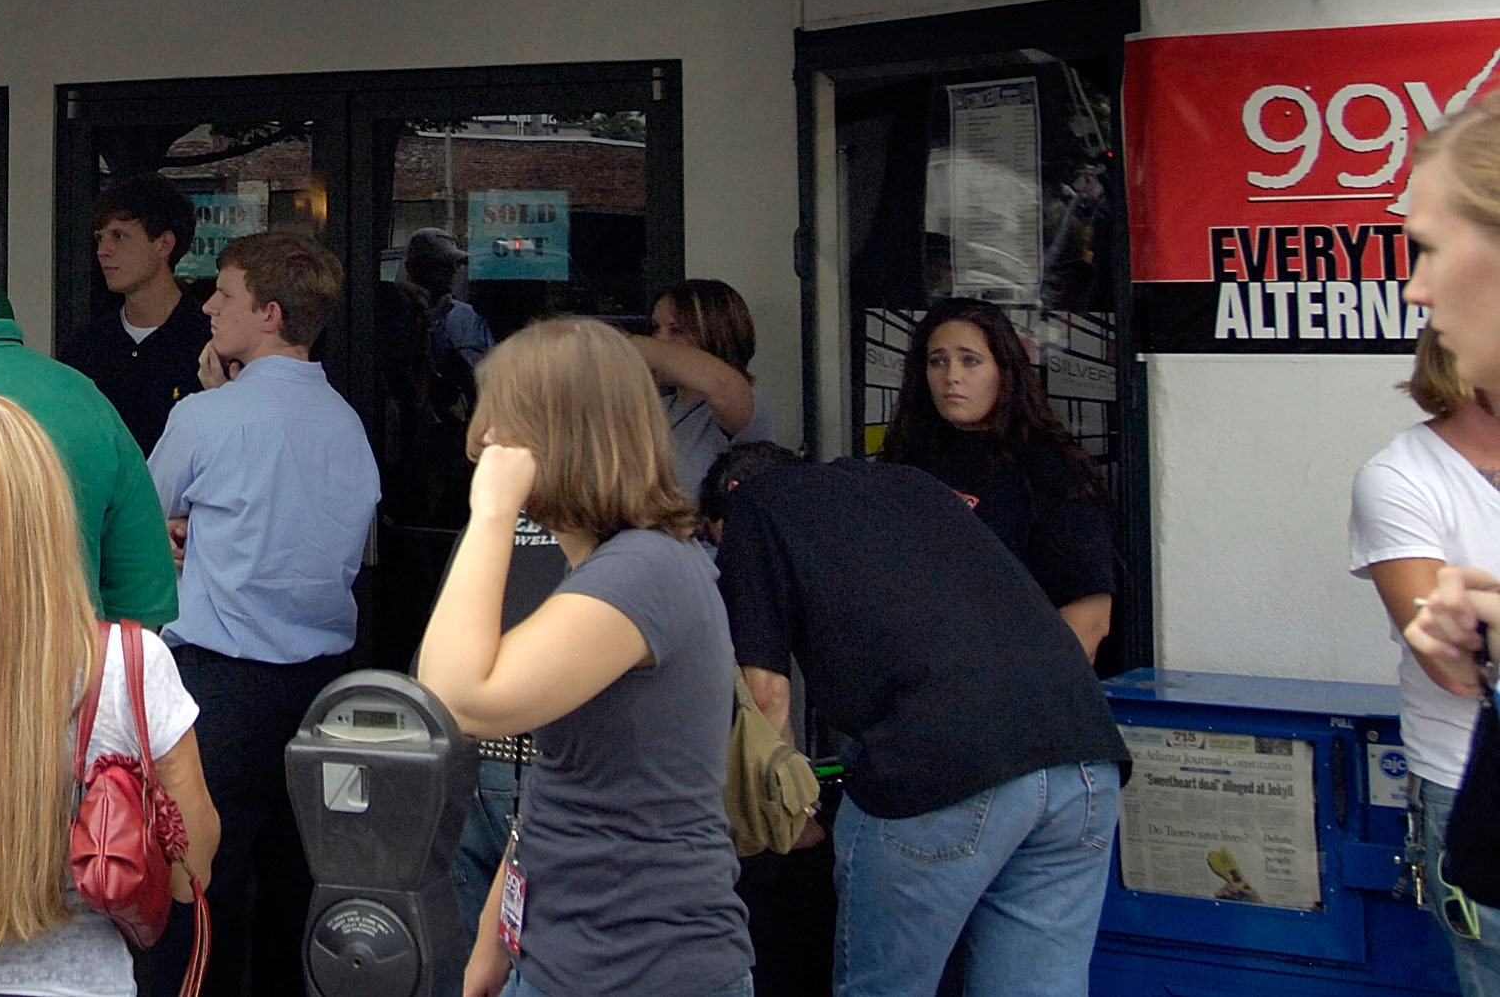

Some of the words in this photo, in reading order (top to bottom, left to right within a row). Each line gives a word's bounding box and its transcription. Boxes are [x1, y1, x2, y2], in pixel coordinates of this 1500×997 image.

[195, 205, 246, 224] OLD
[483, 203, 557, 223] SOLD
[1329, 716, 1355, 729] PULL
[1173, 731, 1197, 743] 715
[1142, 749, 1181, 763] Atlanta
[1256, 783, 1265, 795] at
